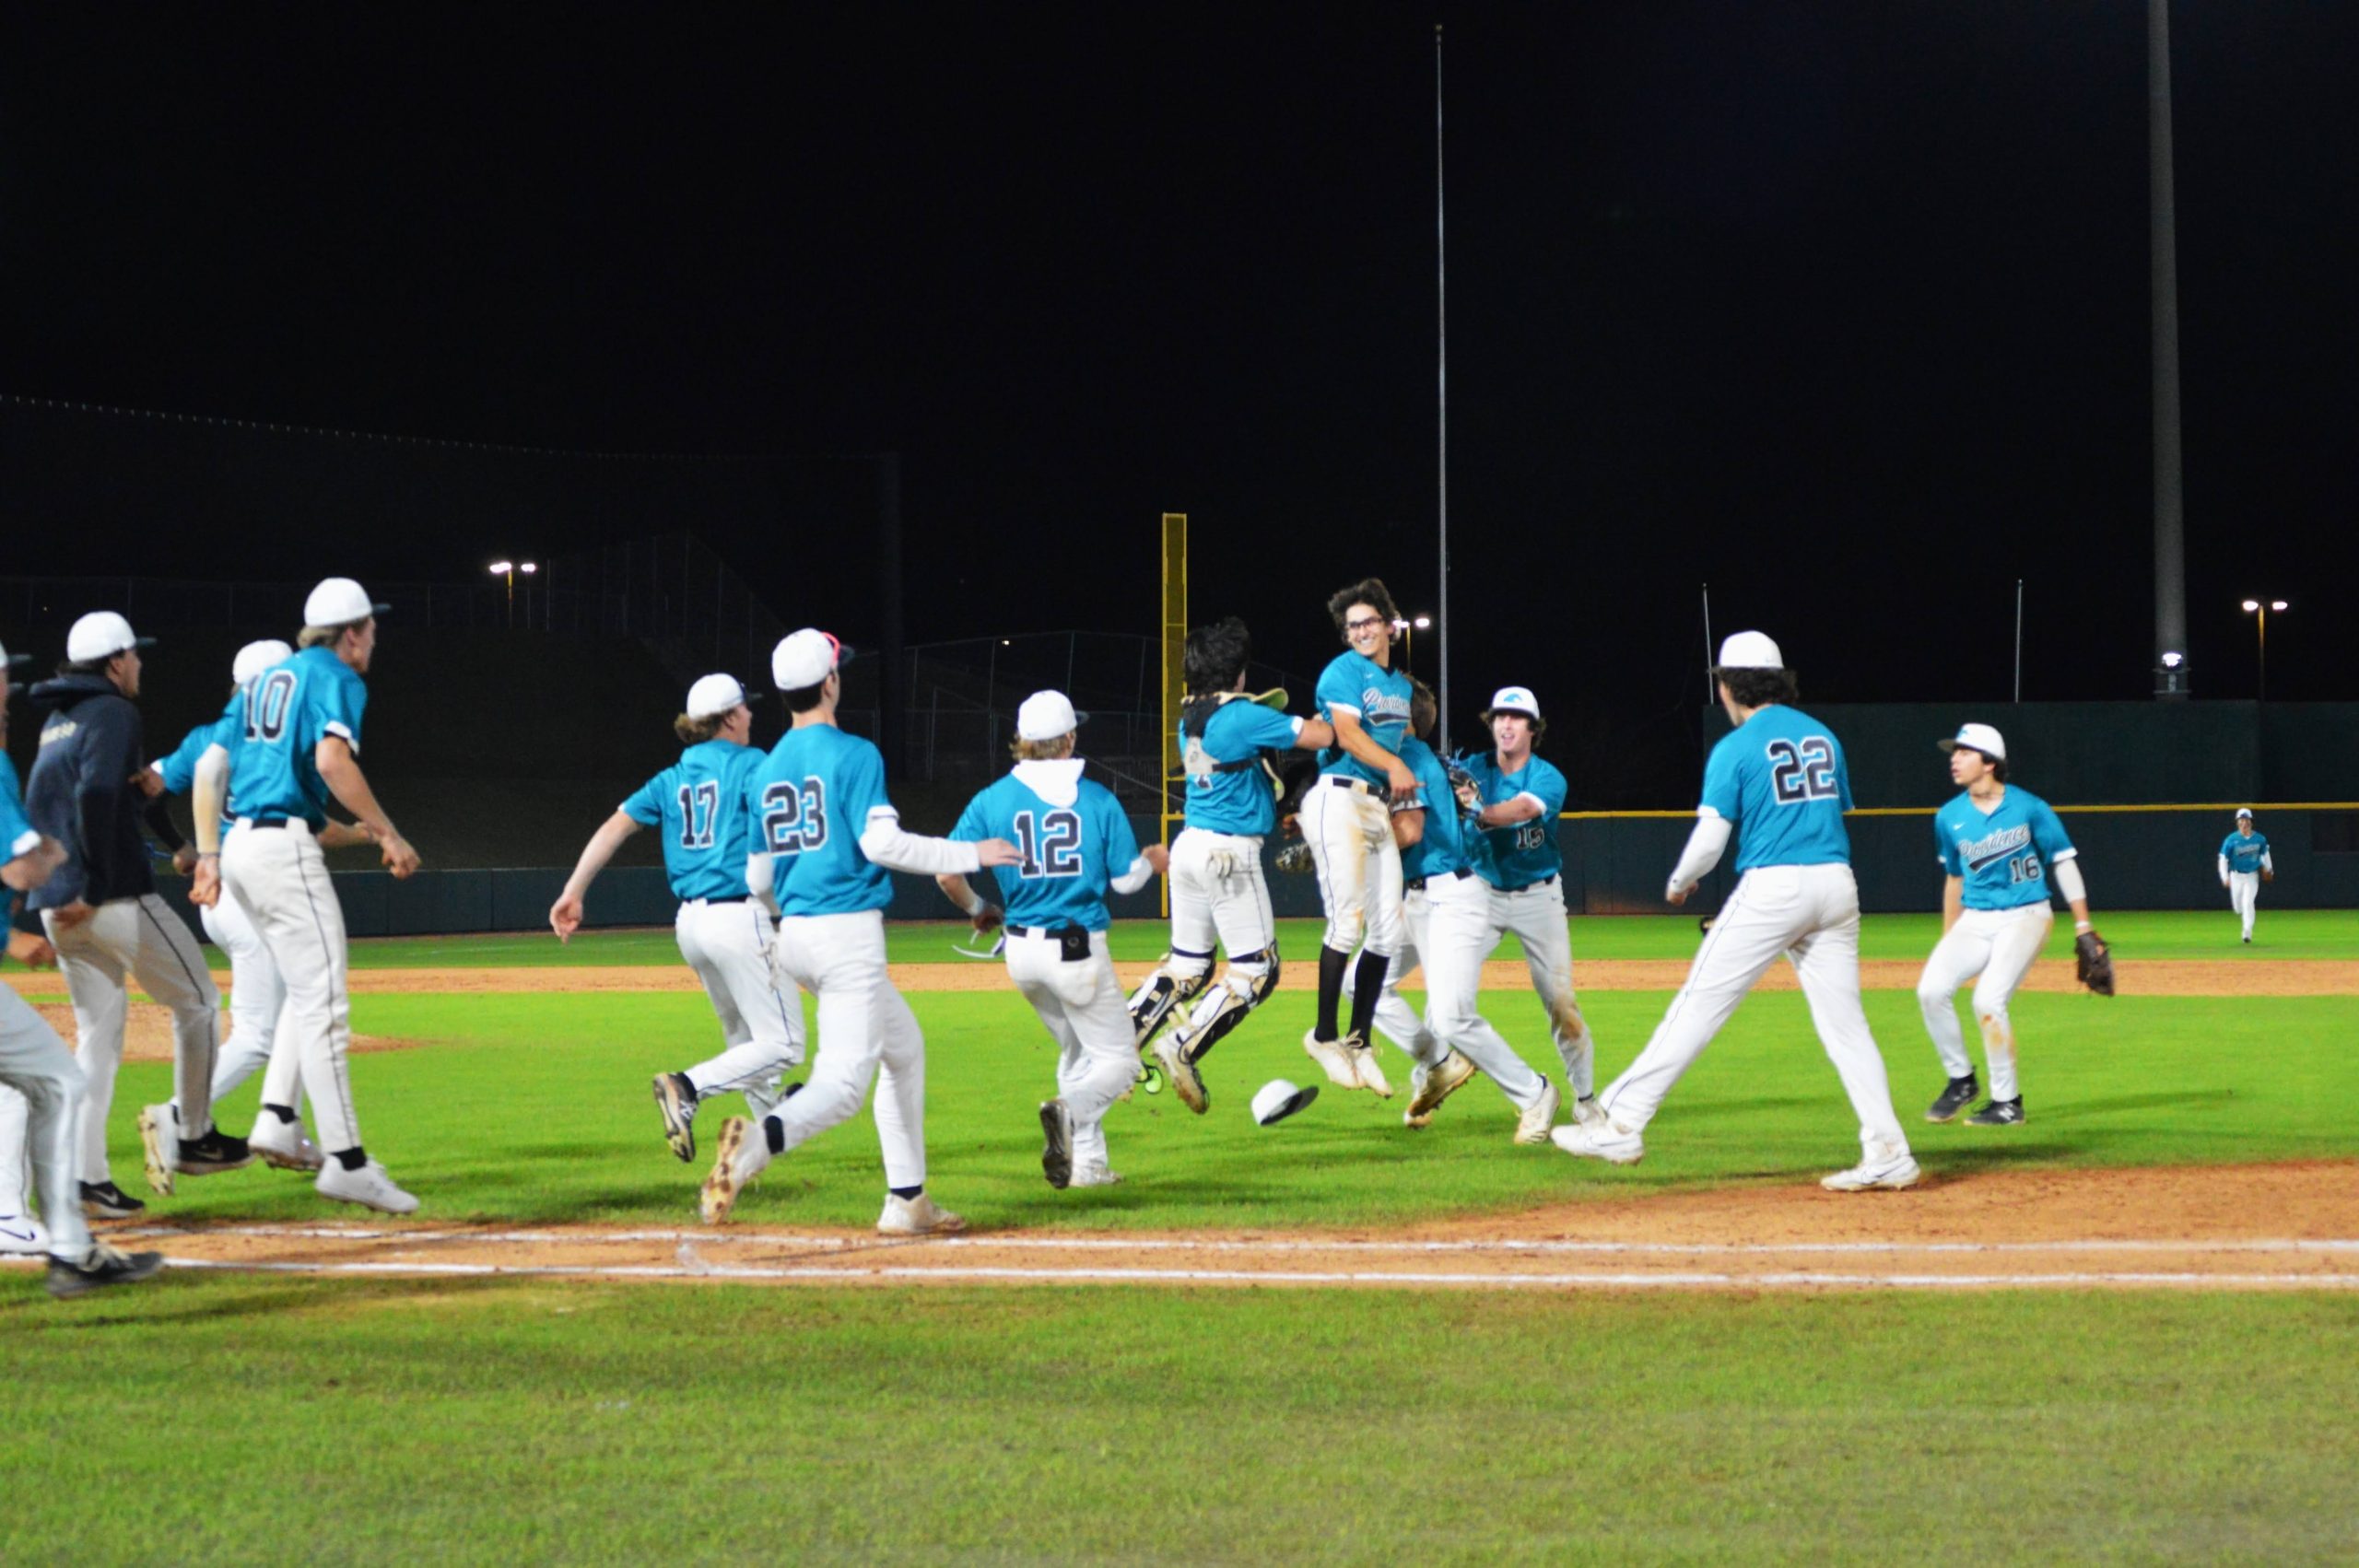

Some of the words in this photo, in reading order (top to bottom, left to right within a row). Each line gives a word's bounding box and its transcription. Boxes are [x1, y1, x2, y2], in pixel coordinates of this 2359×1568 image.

[241, 670, 298, 743] 10
[1766, 735, 1839, 804] 22
[678, 779, 719, 849] 17
[762, 775, 828, 856] 23
[1014, 808, 1082, 878] 12
[1517, 827, 1544, 848] 15
[2010, 855, 2043, 884] 16
